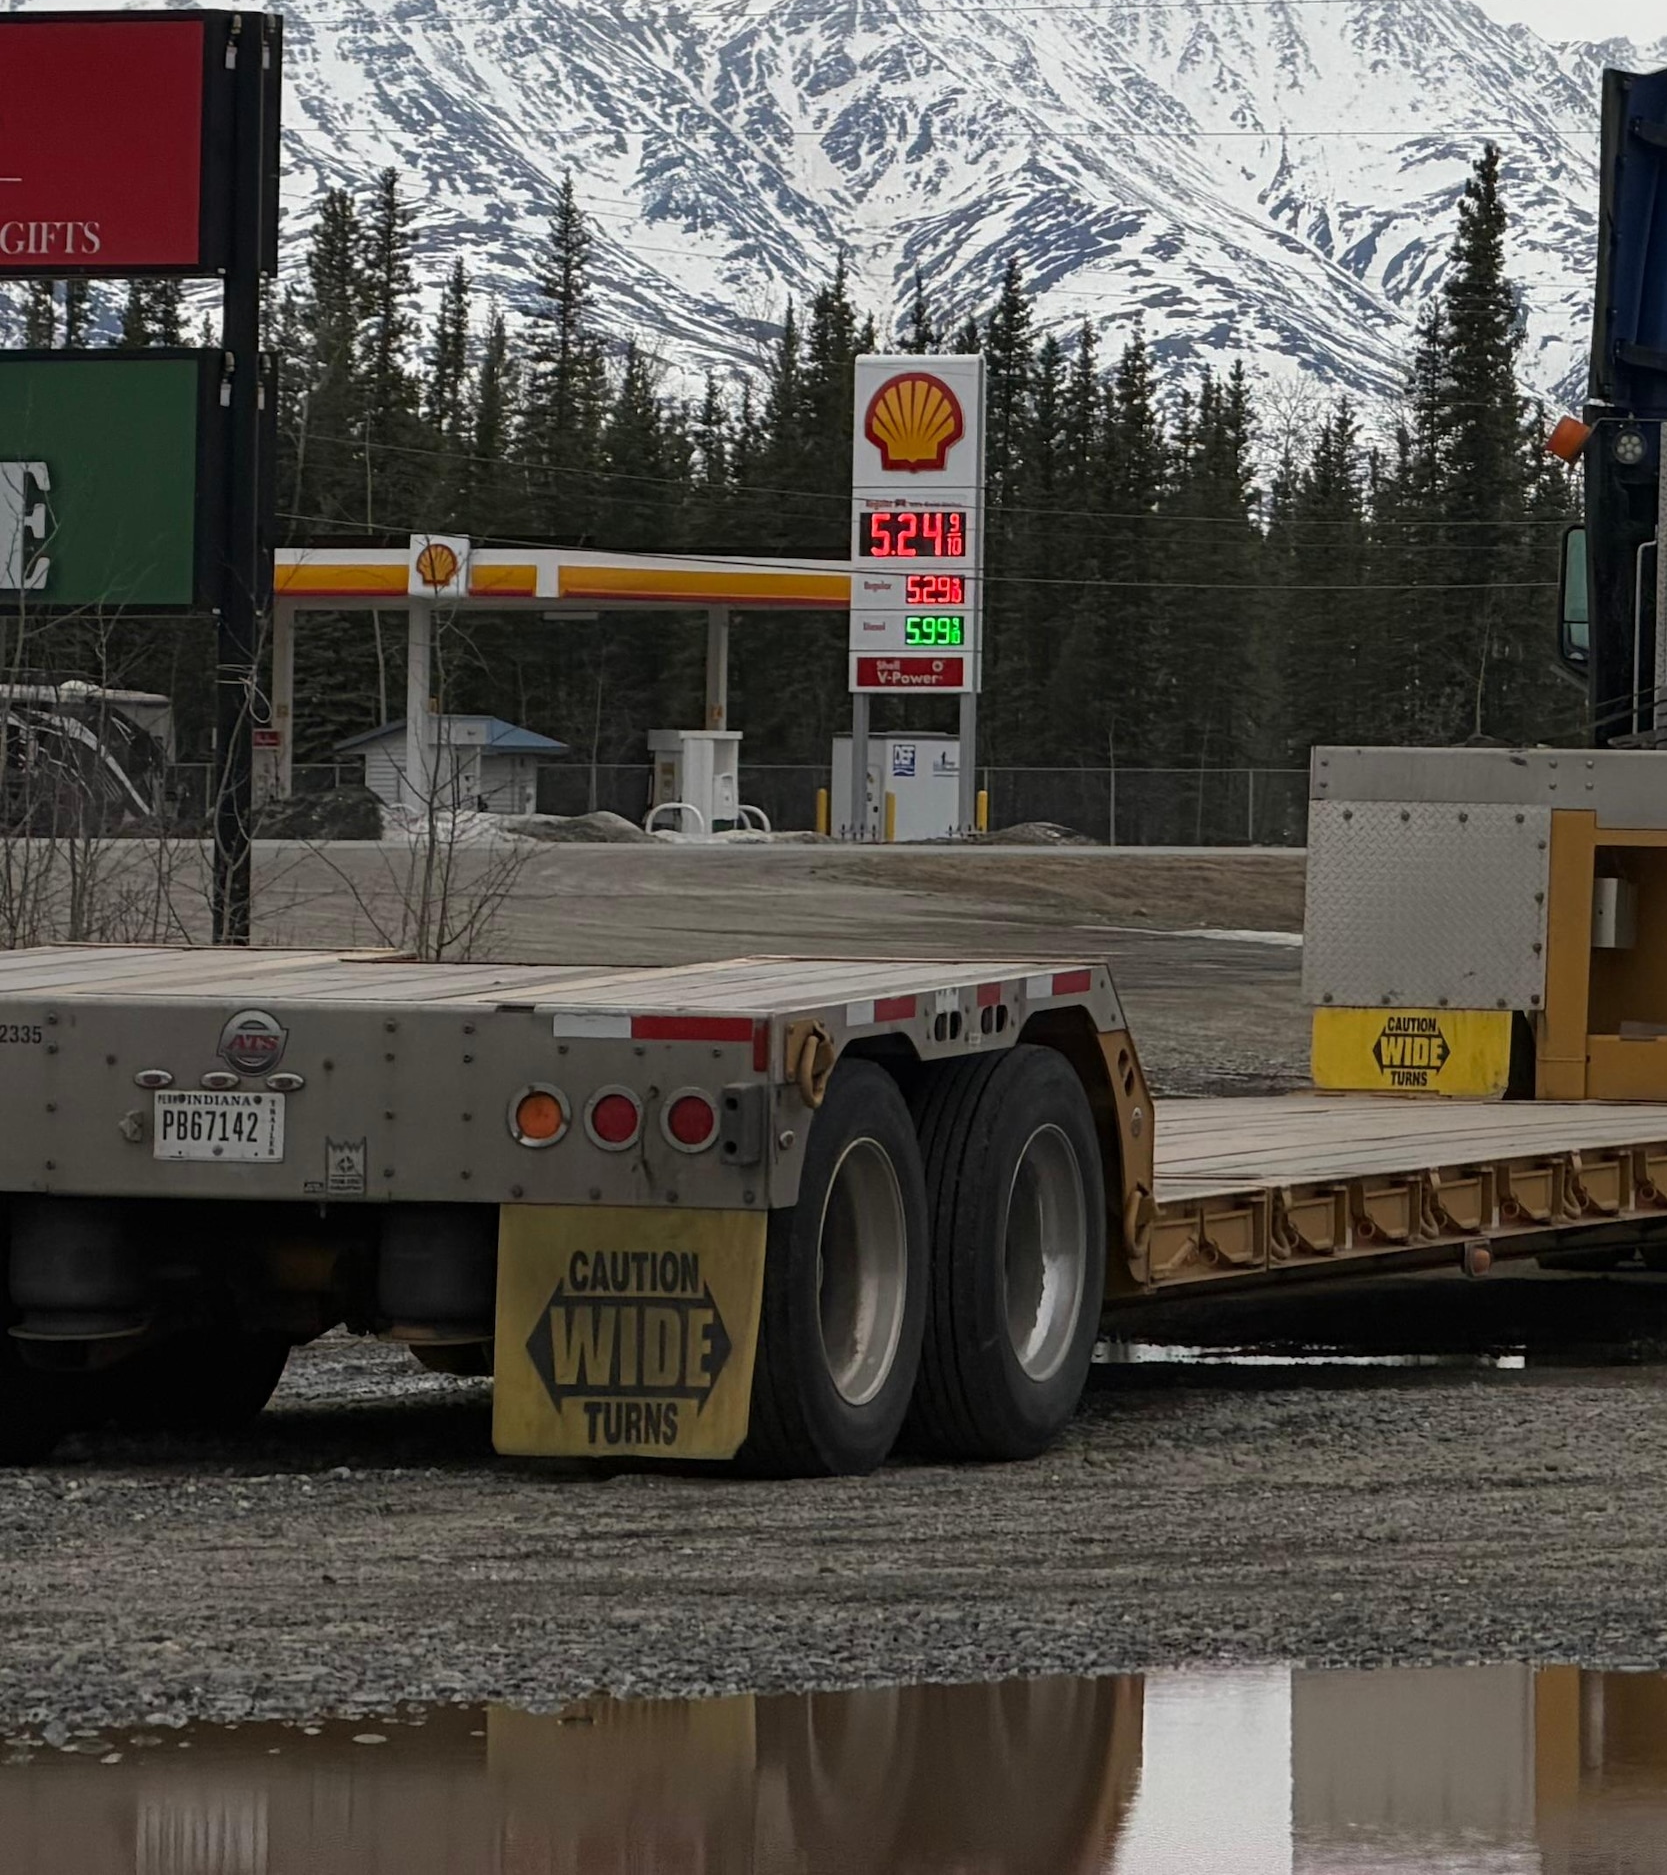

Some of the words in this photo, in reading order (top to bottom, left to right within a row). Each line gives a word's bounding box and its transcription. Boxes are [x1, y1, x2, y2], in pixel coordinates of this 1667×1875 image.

[0, 221, 101, 255] GIFTS
[876, 660, 901, 670] Shell
[877, 672, 940, 684] V-Power
[1387, 1017, 1437, 1032] CAUTION
[225, 1034, 280, 1052] ATS
[1381, 1036, 1443, 1066] WIDE
[1391, 1071, 1428, 1086] TURNS
[187, 1094, 251, 1106] INDIANA
[162, 1110, 259, 1143] PB67142
[268, 1099, 276, 1156] TRAILER
[569, 1250, 699, 1294] CAUTION
[550, 1305, 715, 1387] WIDE
[583, 1401, 679, 1446] TURNS
